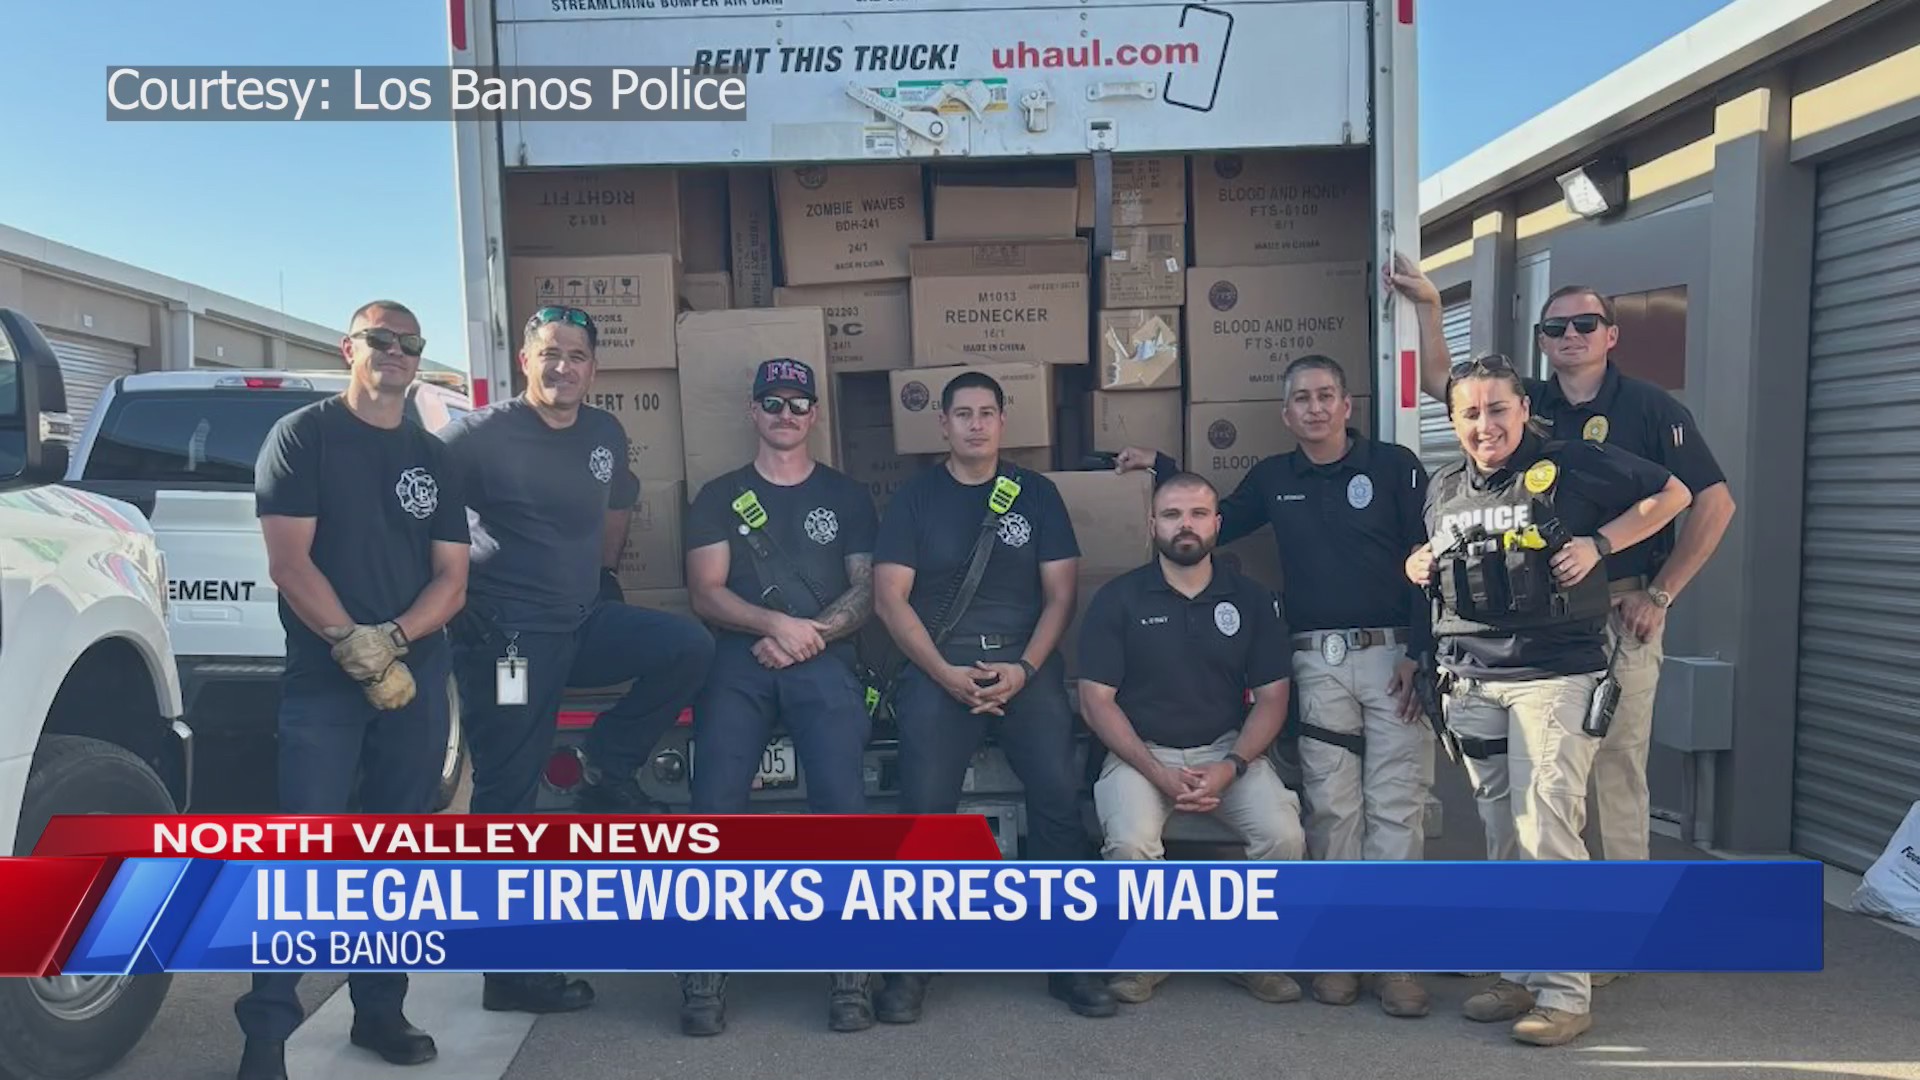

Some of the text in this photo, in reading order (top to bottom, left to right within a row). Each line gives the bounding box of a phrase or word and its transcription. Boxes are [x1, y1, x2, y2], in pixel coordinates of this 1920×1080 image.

[693, 44, 959, 75] RENT THIS TRUCK!
[992, 39, 1199, 69] uhaul.com
[536, 190, 635, 206] RIGHT FIT
[1218, 182, 1349, 202] BLOOD AND HONEY
[805, 197, 905, 217] ZOMBIE WAVES
[849, 243, 868, 254] 24/1
[1254, 239, 1321, 250] MADE IN CHINA
[863, 259, 884, 269] CHINA
[978, 291, 1017, 303] M1013
[944, 308, 1048, 323] REDNECKER
[1213, 315, 1345, 335] BLOOD AND HONEY
[962, 342, 1026, 352] MADE IN CHINA
[1245, 336, 1314, 350] FTS-6100
[1269, 352, 1290, 363] 6/1
[766, 361, 808, 385] Fire
[1249, 373, 1275, 383] MADE
[634, 393, 660, 411] 100
[1212, 456, 1259, 470] BLOOD
[1441, 504, 1529, 532] POLICE
[169, 580, 256, 601] EMENT
[761, 748, 785, 774] 05
